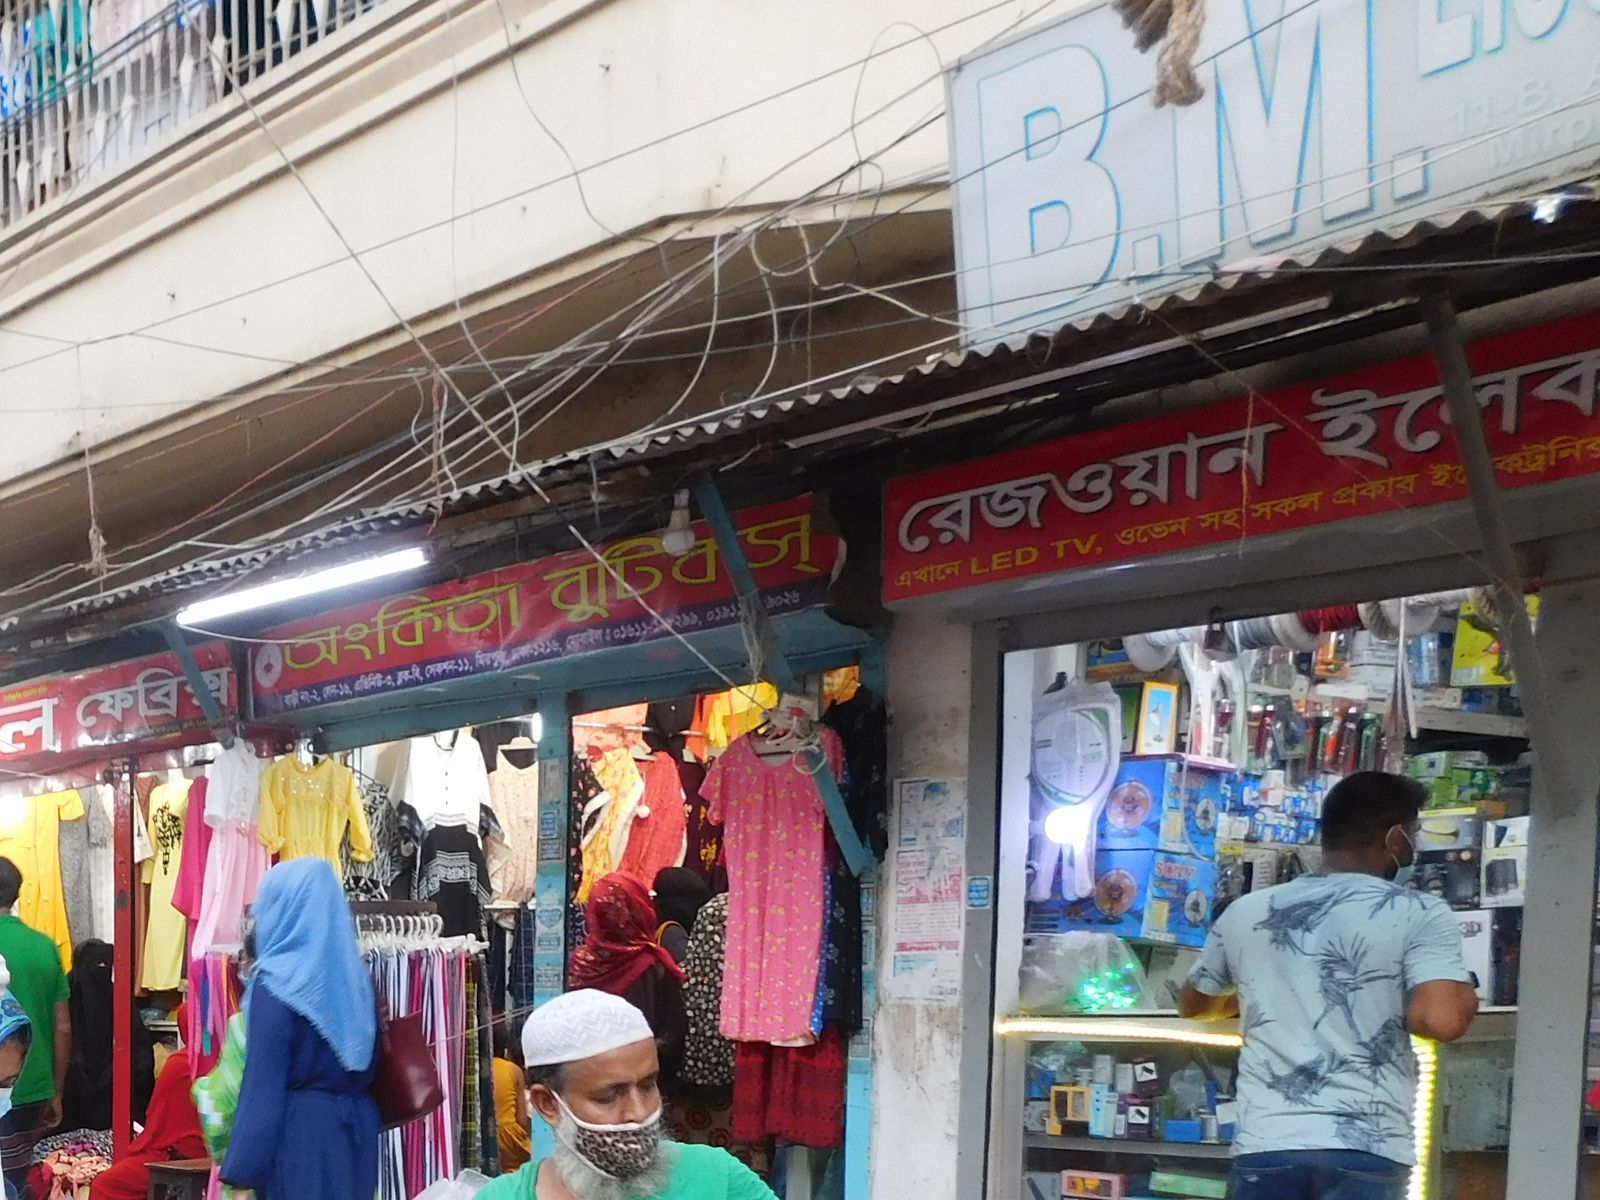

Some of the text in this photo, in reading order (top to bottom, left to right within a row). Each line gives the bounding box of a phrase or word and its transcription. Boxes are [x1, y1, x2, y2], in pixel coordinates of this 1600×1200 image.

[894, 558, 963, 587] এখানে
[971, 546, 1039, 575] LED
[1050, 533, 1103, 560] TV,
[1114, 516, 1191, 546] ওভেন
[1197, 508, 1242, 531] সহ
[1250, 489, 1325, 521] সকল
[1332, 471, 1418, 506] প্রকার
[898, 420, 1285, 552] রেজওয়ান
